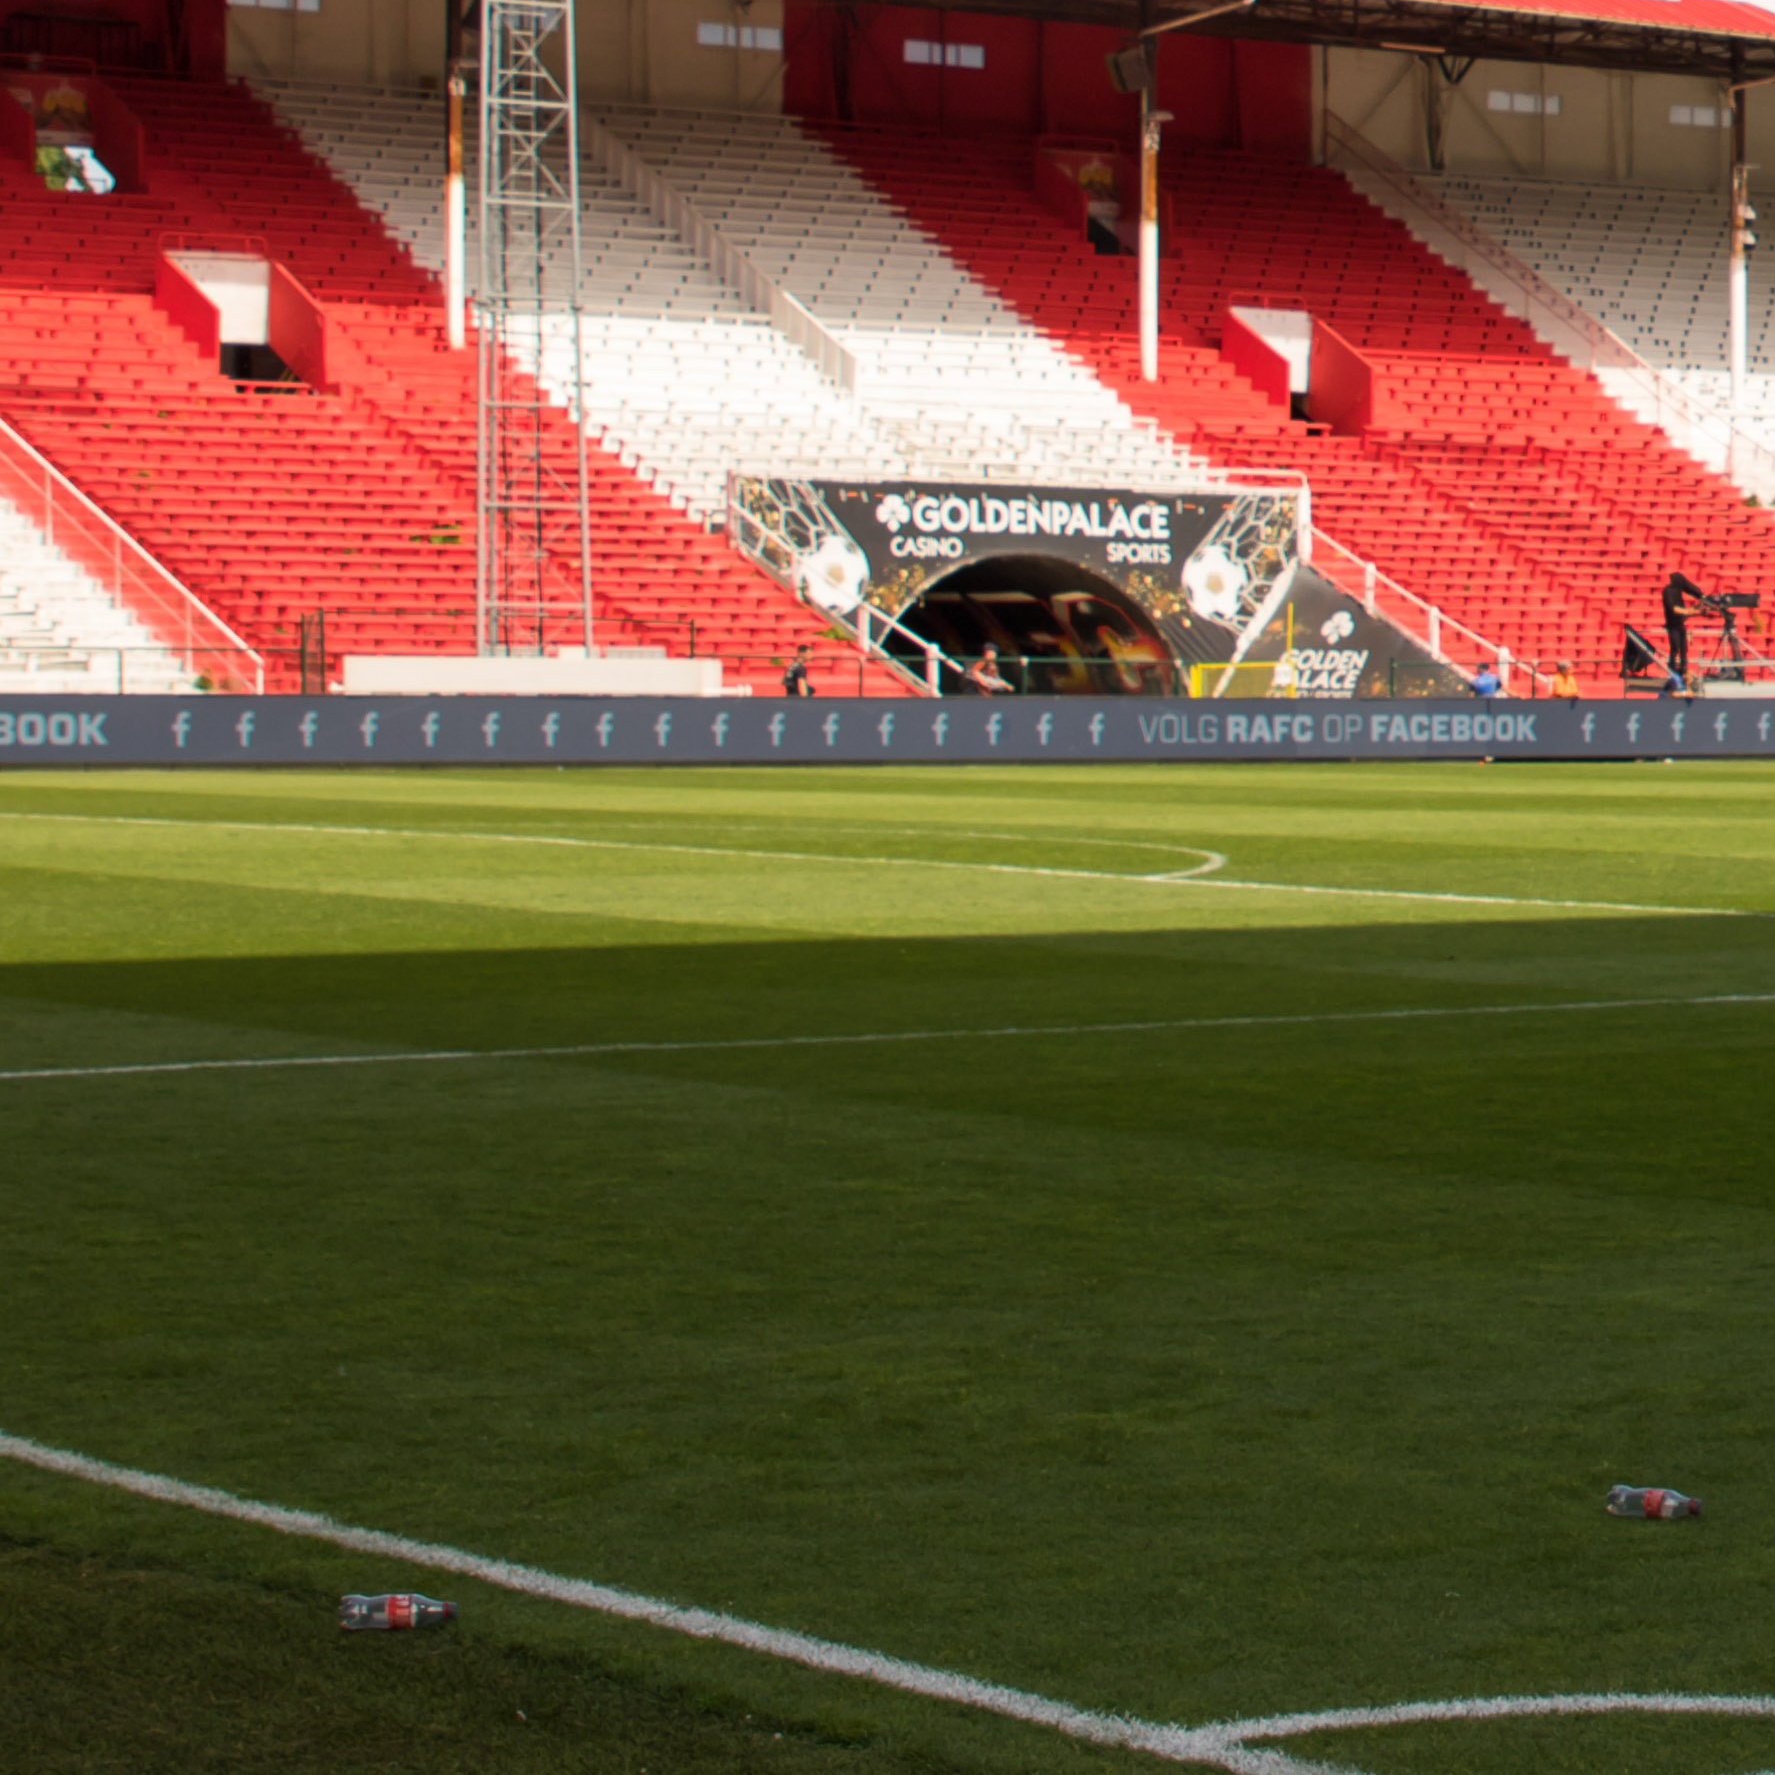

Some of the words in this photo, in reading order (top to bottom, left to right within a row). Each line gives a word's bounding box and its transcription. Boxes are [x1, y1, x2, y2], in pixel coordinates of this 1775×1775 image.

[912, 494, 1171, 540] GOLDENPALACE
[890, 535, 965, 560] CASINO
[1106, 541, 1172, 566] SPORTS
[1280, 648, 1370, 671] GOLDEN
[1276, 669, 1361, 690] ALACE
[1138, 713, 1218, 744] VOLG
[1225, 715, 1314, 744] RAFC
[1322, 714, 1363, 743] OP
[1370, 714, 1537, 742] FACEBOOK
